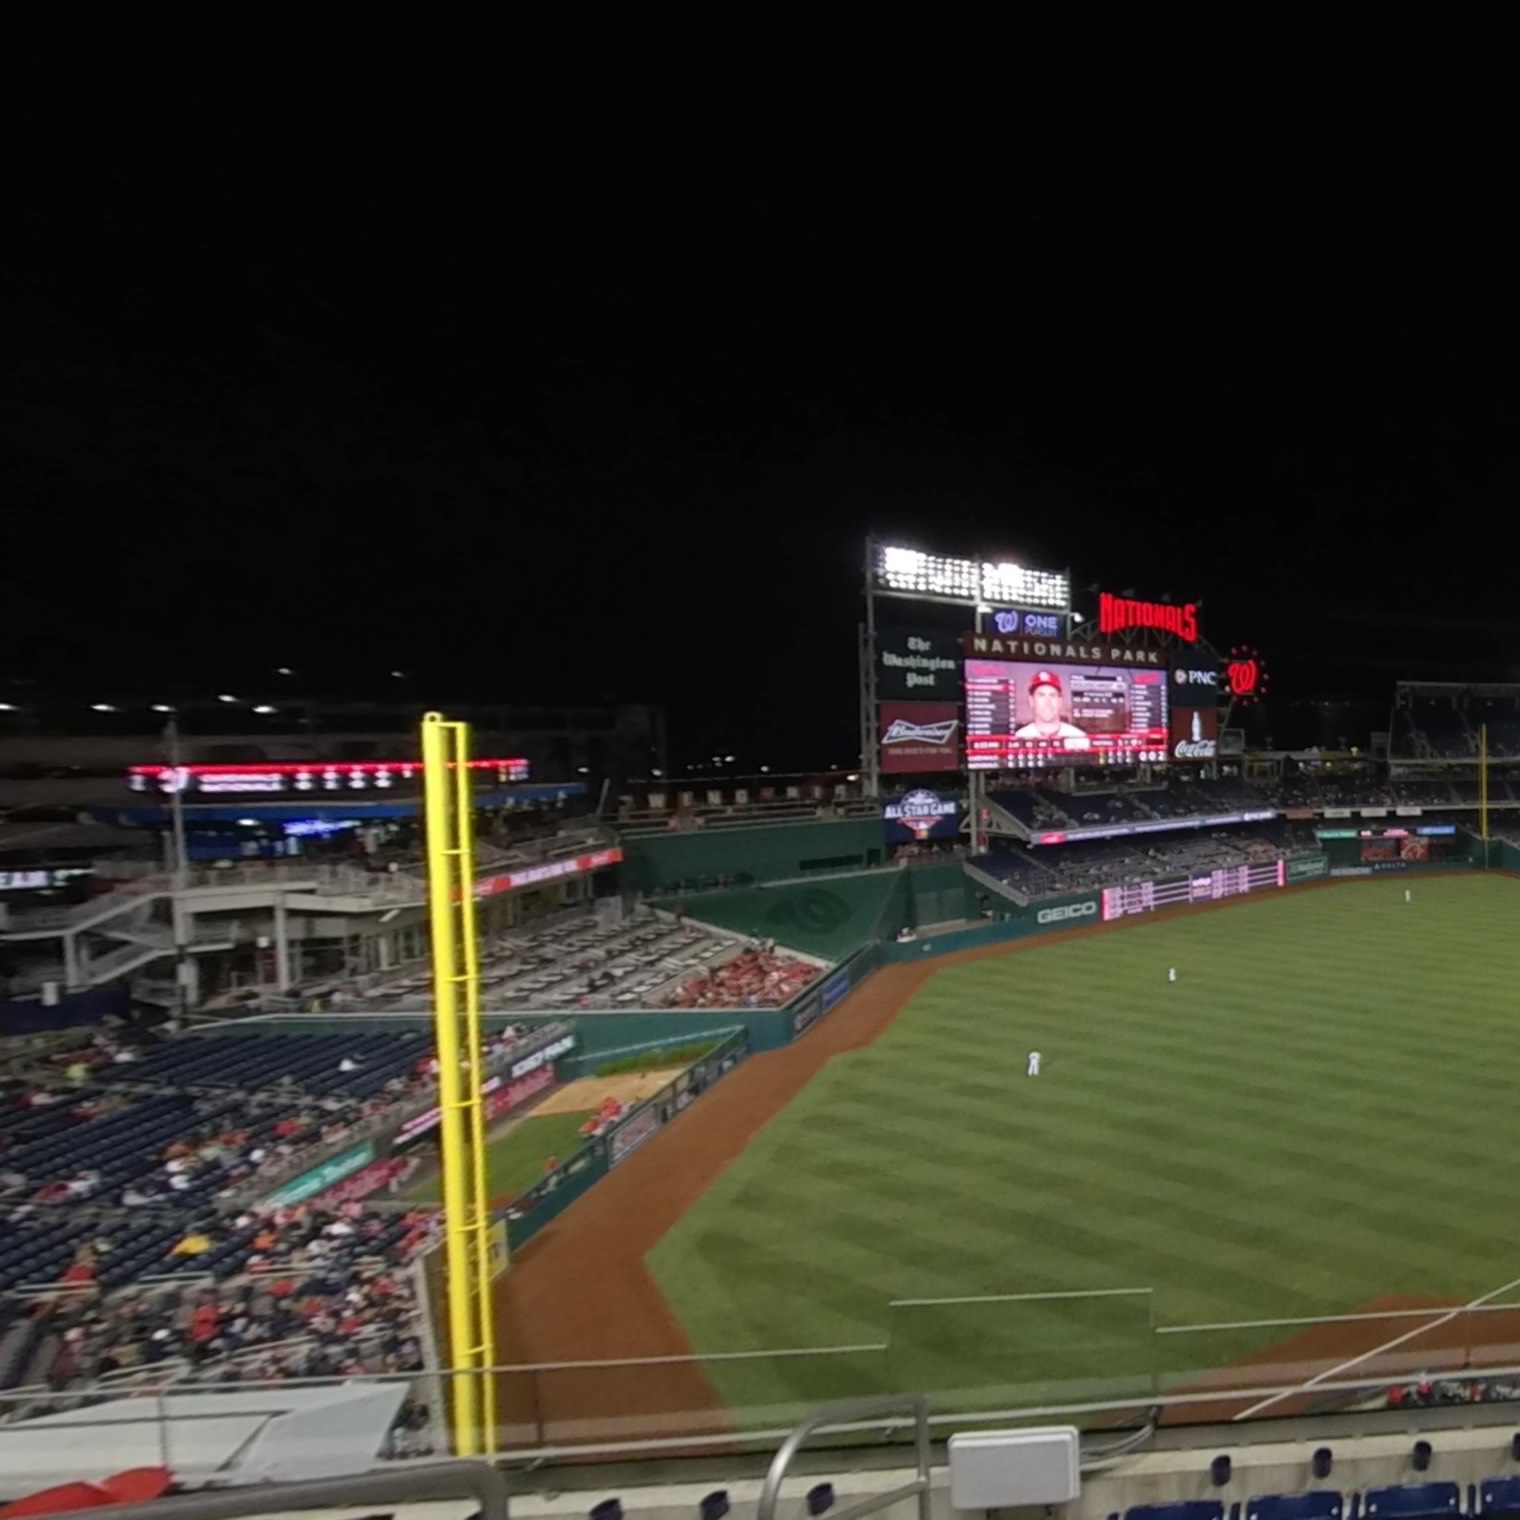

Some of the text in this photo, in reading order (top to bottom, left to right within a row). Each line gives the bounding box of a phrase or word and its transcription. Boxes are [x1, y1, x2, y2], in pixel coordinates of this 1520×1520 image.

[1024, 614, 1058, 629] ONE
[1099, 592, 1197, 643] NATIONALS
[906, 636, 931, 651] The
[973, 638, 1159, 664] NATIONALS PARK
[882, 651, 956, 671] Washington
[905, 672, 935, 688] Post
[1188, 670, 1217, 686] PNC
[903, 803, 930, 817] STAR
[1037, 901, 1097, 924] GEICO
